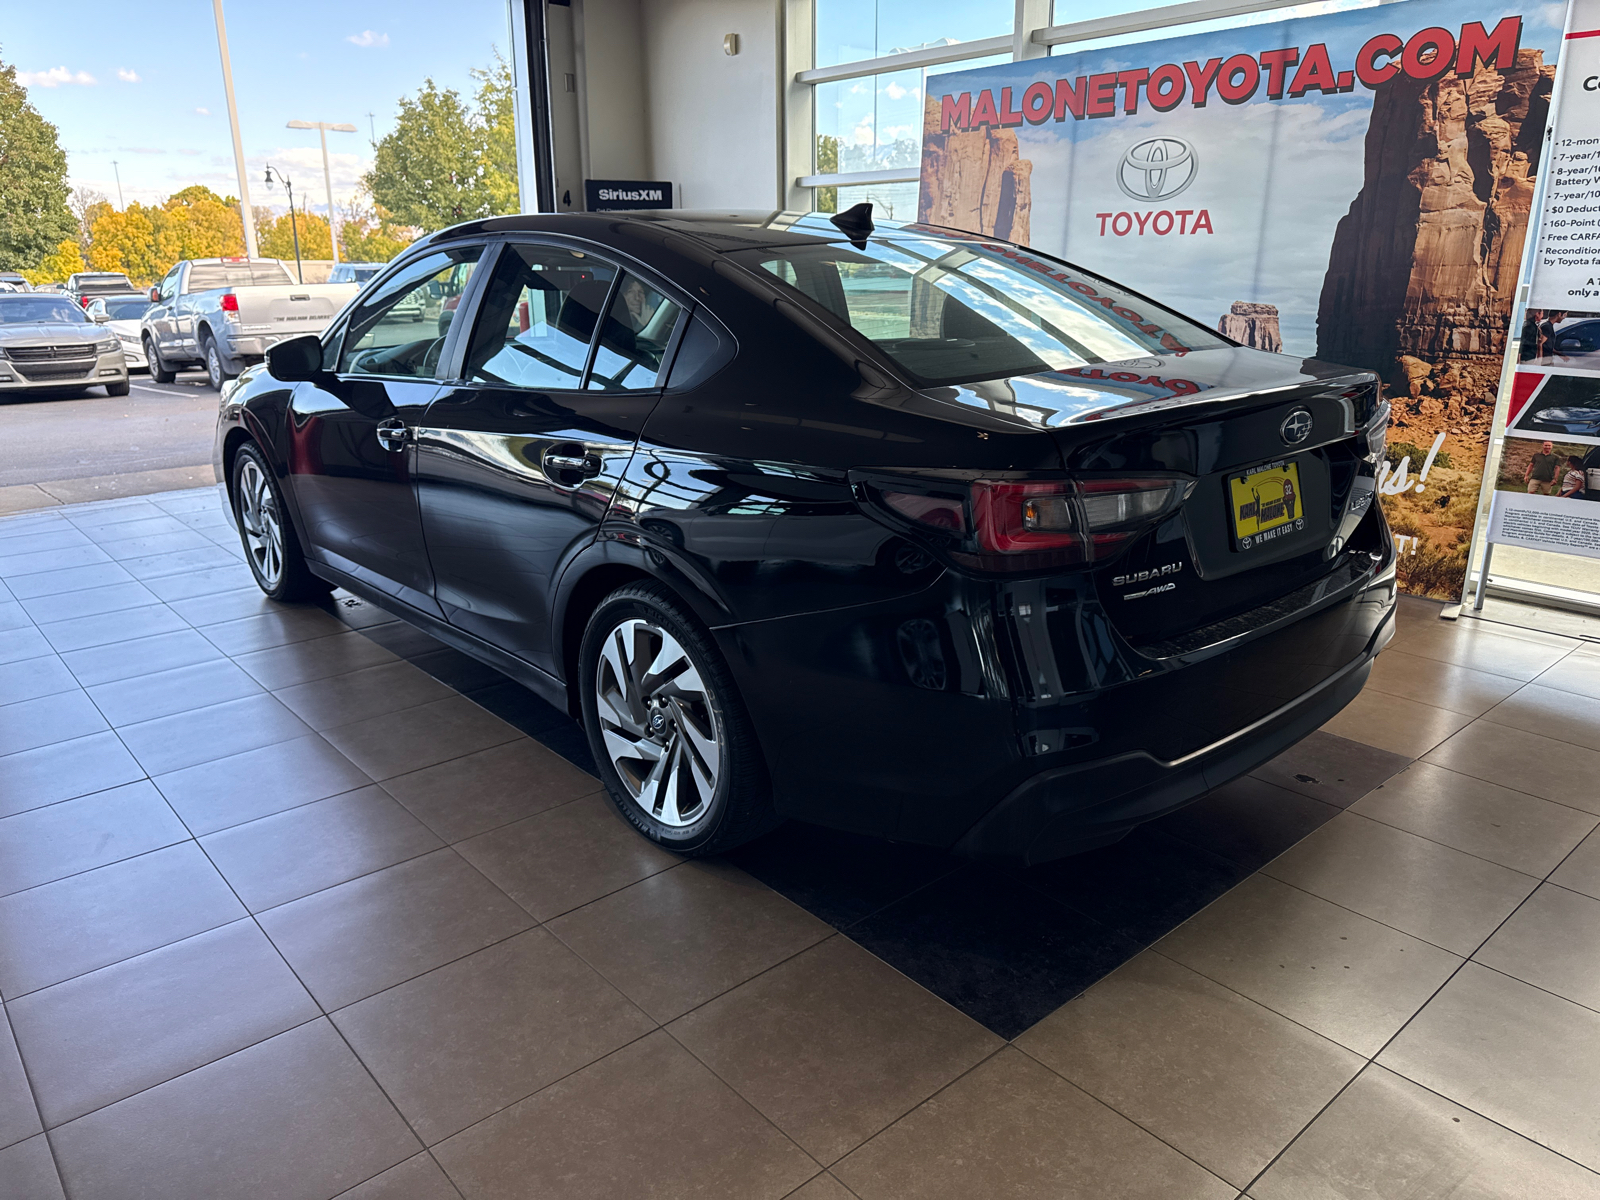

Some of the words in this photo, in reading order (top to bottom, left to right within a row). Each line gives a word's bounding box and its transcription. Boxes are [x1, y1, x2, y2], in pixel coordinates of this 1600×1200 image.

[940, 15, 1523, 134] MALONETOYOTA.COM
[1562, 138, 1600, 146] 12-mon
[1556, 178, 1592, 186] Battery
[563, 190, 571, 207] 4
[598, 188, 662, 200] SiriusXM
[1552, 206, 1564, 214] $0
[1096, 210, 1214, 236] TOYOTA
[1550, 219, 1595, 227] 160-Point
[1544, 258, 1555, 266] by
[1558, 258, 1589, 266] Toyota
[1586, 278, 1594, 286] A
[1568, 288, 1591, 298] only
[1246, 467, 1256, 476] KARL
[1285, 484, 1292, 495] 32
[1255, 534, 1263, 544] WE
[1263, 530, 1276, 540] MAKE
[1277, 528, 1282, 536] IT
[1282, 524, 1293, 535] EASY
[1112, 562, 1182, 587] SUBARU
[1145, 582, 1176, 596] AWD
